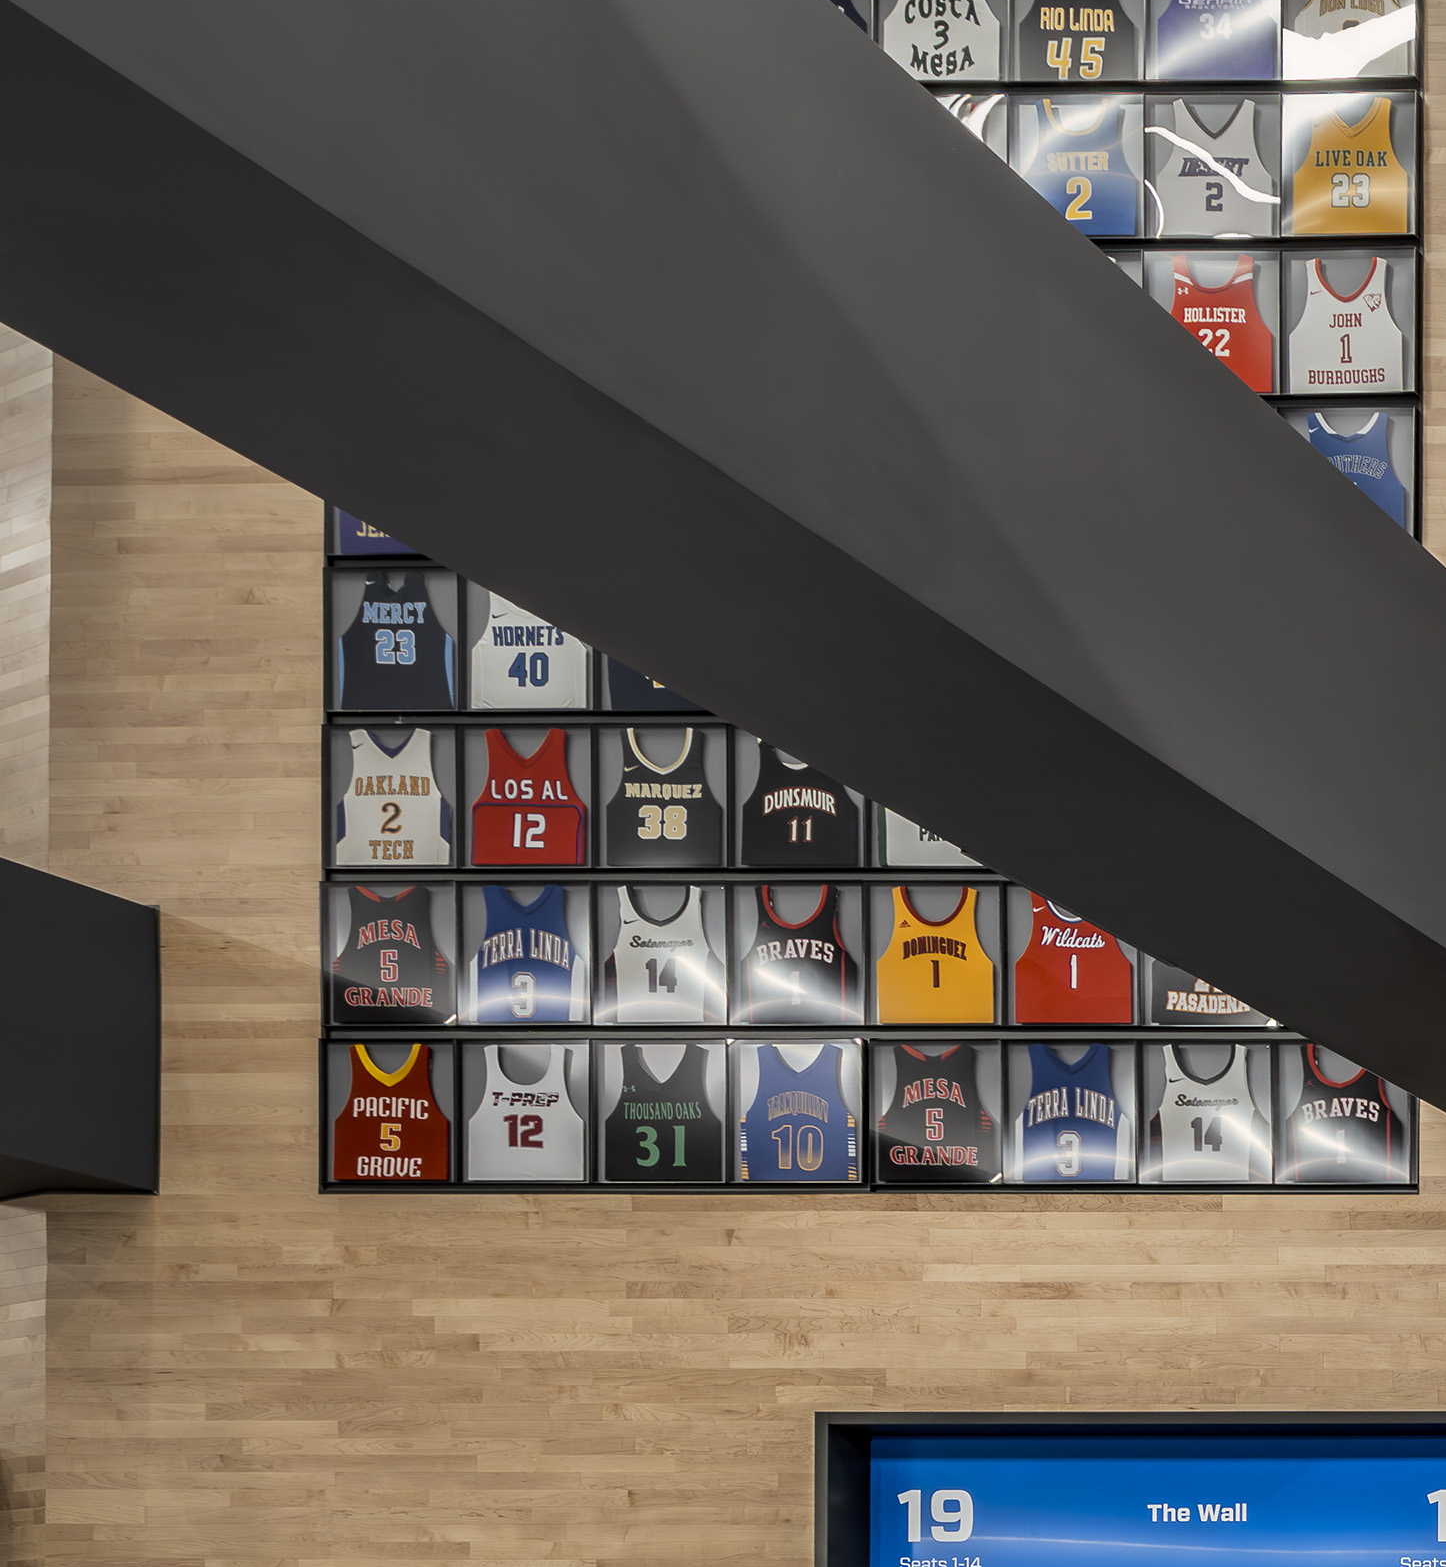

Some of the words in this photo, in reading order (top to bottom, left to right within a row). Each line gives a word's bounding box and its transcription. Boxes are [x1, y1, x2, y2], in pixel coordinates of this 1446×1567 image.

[1041, 7, 1066, 32] RIO
[1070, 6, 1115, 32] LINDA
[1315, 150, 1347, 167] LIVE
[1354, 149, 1388, 166] OAK
[1184, 307, 1246, 323] HOLLISTER
[1329, 313, 1362, 327] JOHN
[1308, 368, 1385, 384] BURROUGHS
[362, 601, 426, 625] MERCY
[375, 629, 416, 664] 23
[508, 652, 549, 687] 40
[354, 775, 430, 797] OAKLAND
[625, 782, 702, 800] MARQUEZ
[763, 789, 837, 816] DUNSMUIR
[638, 805, 688, 839] 38
[369, 840, 414, 860] TECH
[1041, 926, 1105, 949] Wildcats
[902, 938, 967, 960] DOMINGUEZ
[353, 1097, 429, 1119] PACIFIC
[357, 1155, 422, 1177] GROVE
[890, 1146, 978, 1166] GRANDE
[898, 1488, 973, 1544] 19
[1147, 1504, 1191, 1522] The
[1198, 1504, 1247, 1522] Wall
